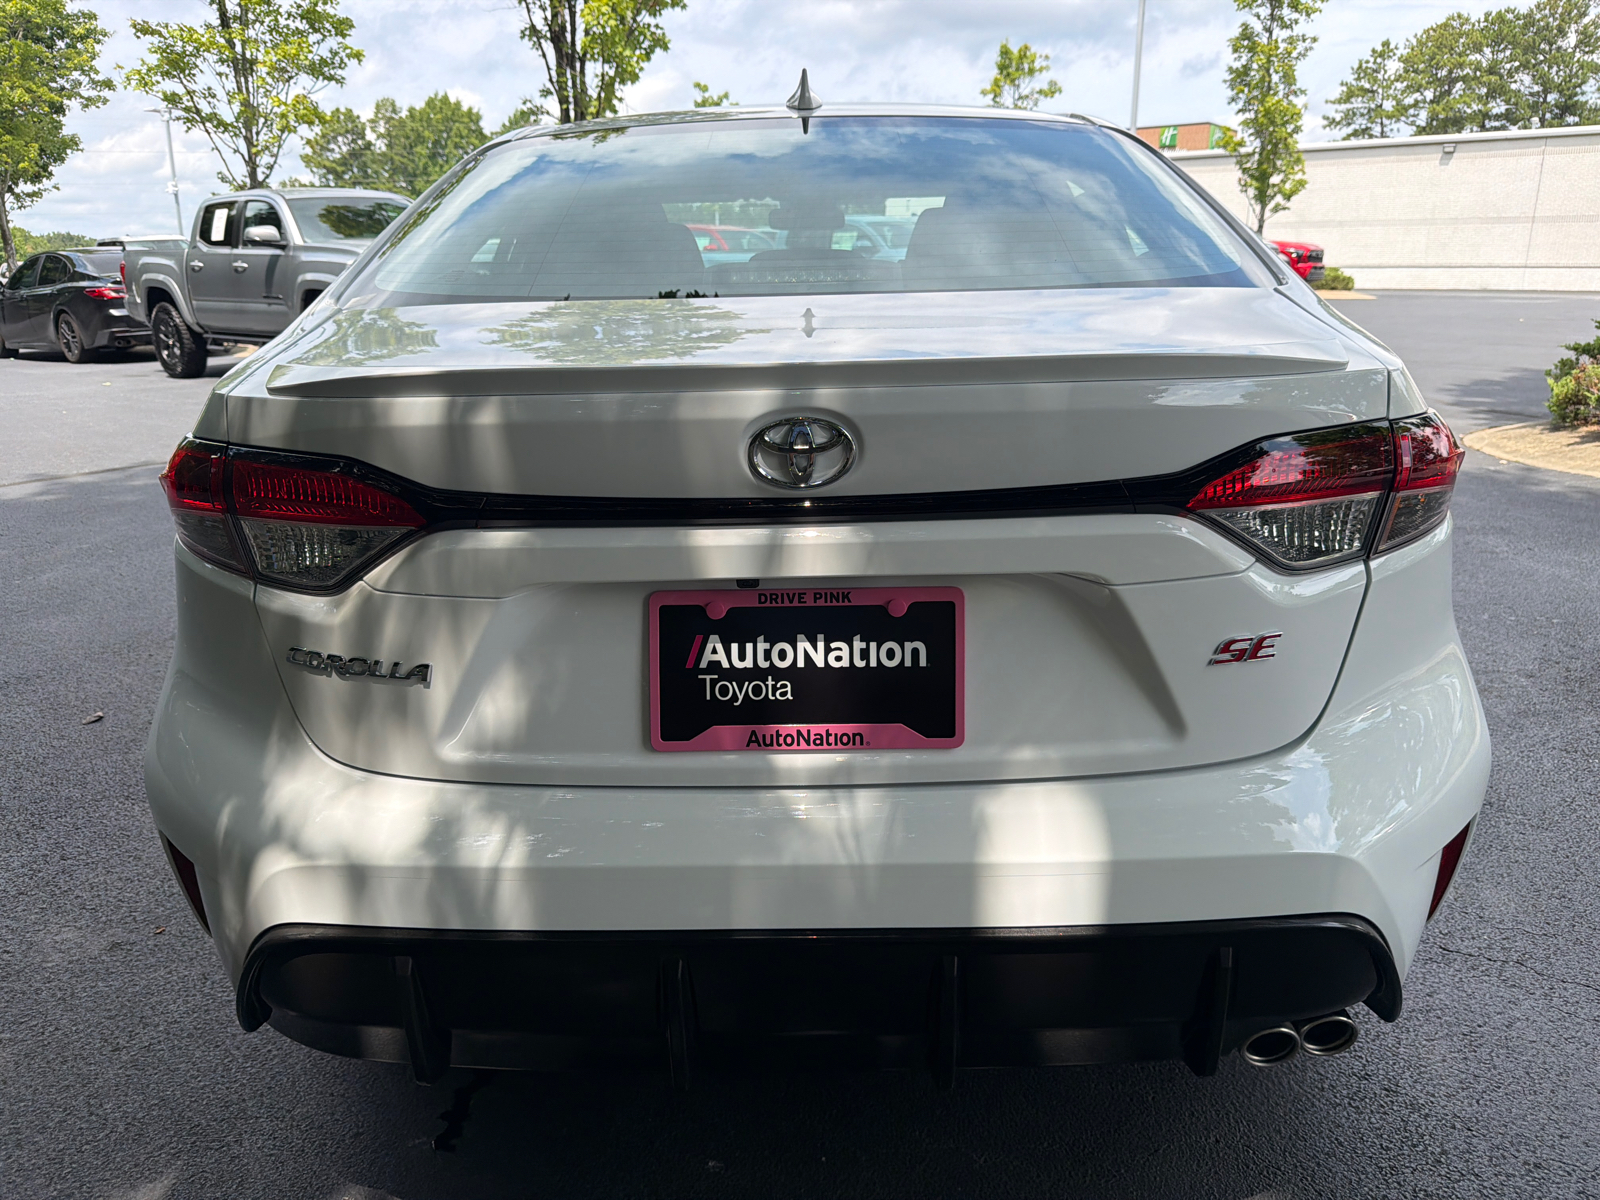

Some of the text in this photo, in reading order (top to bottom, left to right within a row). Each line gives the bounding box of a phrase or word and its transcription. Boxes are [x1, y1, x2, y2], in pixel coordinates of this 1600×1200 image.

[757, 591, 852, 605] DRIVE PINK
[699, 634, 927, 669] AutoNation
[1207, 629, 1283, 666] SE
[285, 646, 433, 684] COROLLA
[698, 675, 793, 706] Toyota
[745, 729, 865, 748] AutoNation
